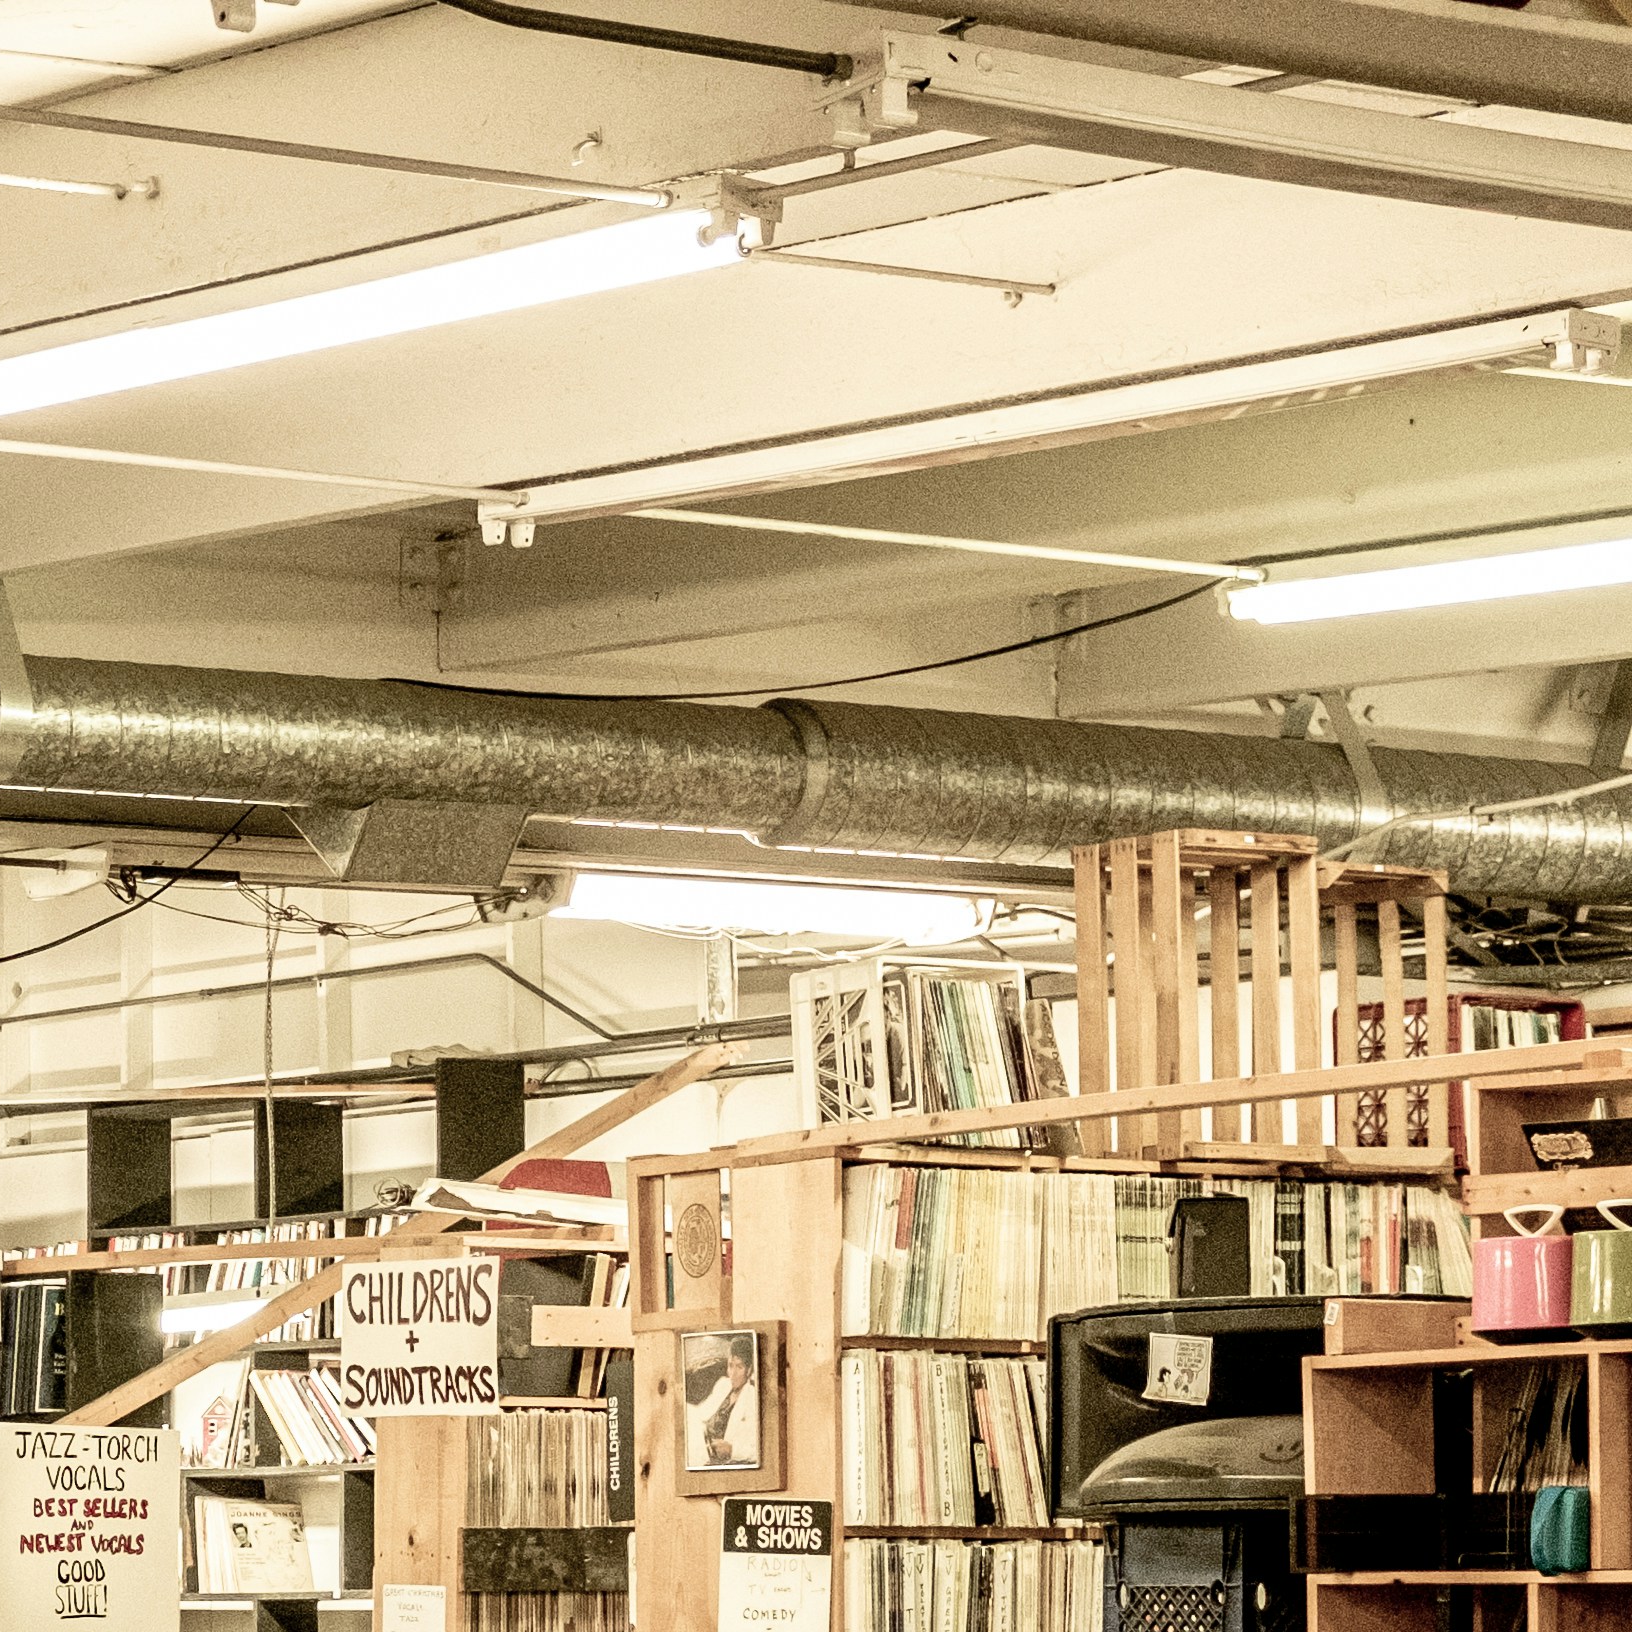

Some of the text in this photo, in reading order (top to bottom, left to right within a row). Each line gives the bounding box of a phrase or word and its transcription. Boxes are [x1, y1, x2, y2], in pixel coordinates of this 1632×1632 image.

[348, 1266, 491, 1325] CHILDRENS
[346, 1365, 496, 1408] SOUNDTRACKS
[608, 1396, 620, 1492] CHILDRENS
[46, 1465, 125, 1491] VOCALS
[33, 1497, 148, 1519] BEST SELLERS
[746, 1504, 813, 1527] MOVIES
[71, 1519, 94, 1531] AND
[20, 1533, 85, 1554] NEWEST
[735, 1526, 822, 1550] & SHOWS
[57, 1559, 105, 1583] GOOD
[55, 1584, 107, 1615] STUFF!
[743, 1607, 796, 1622] COMEDY
